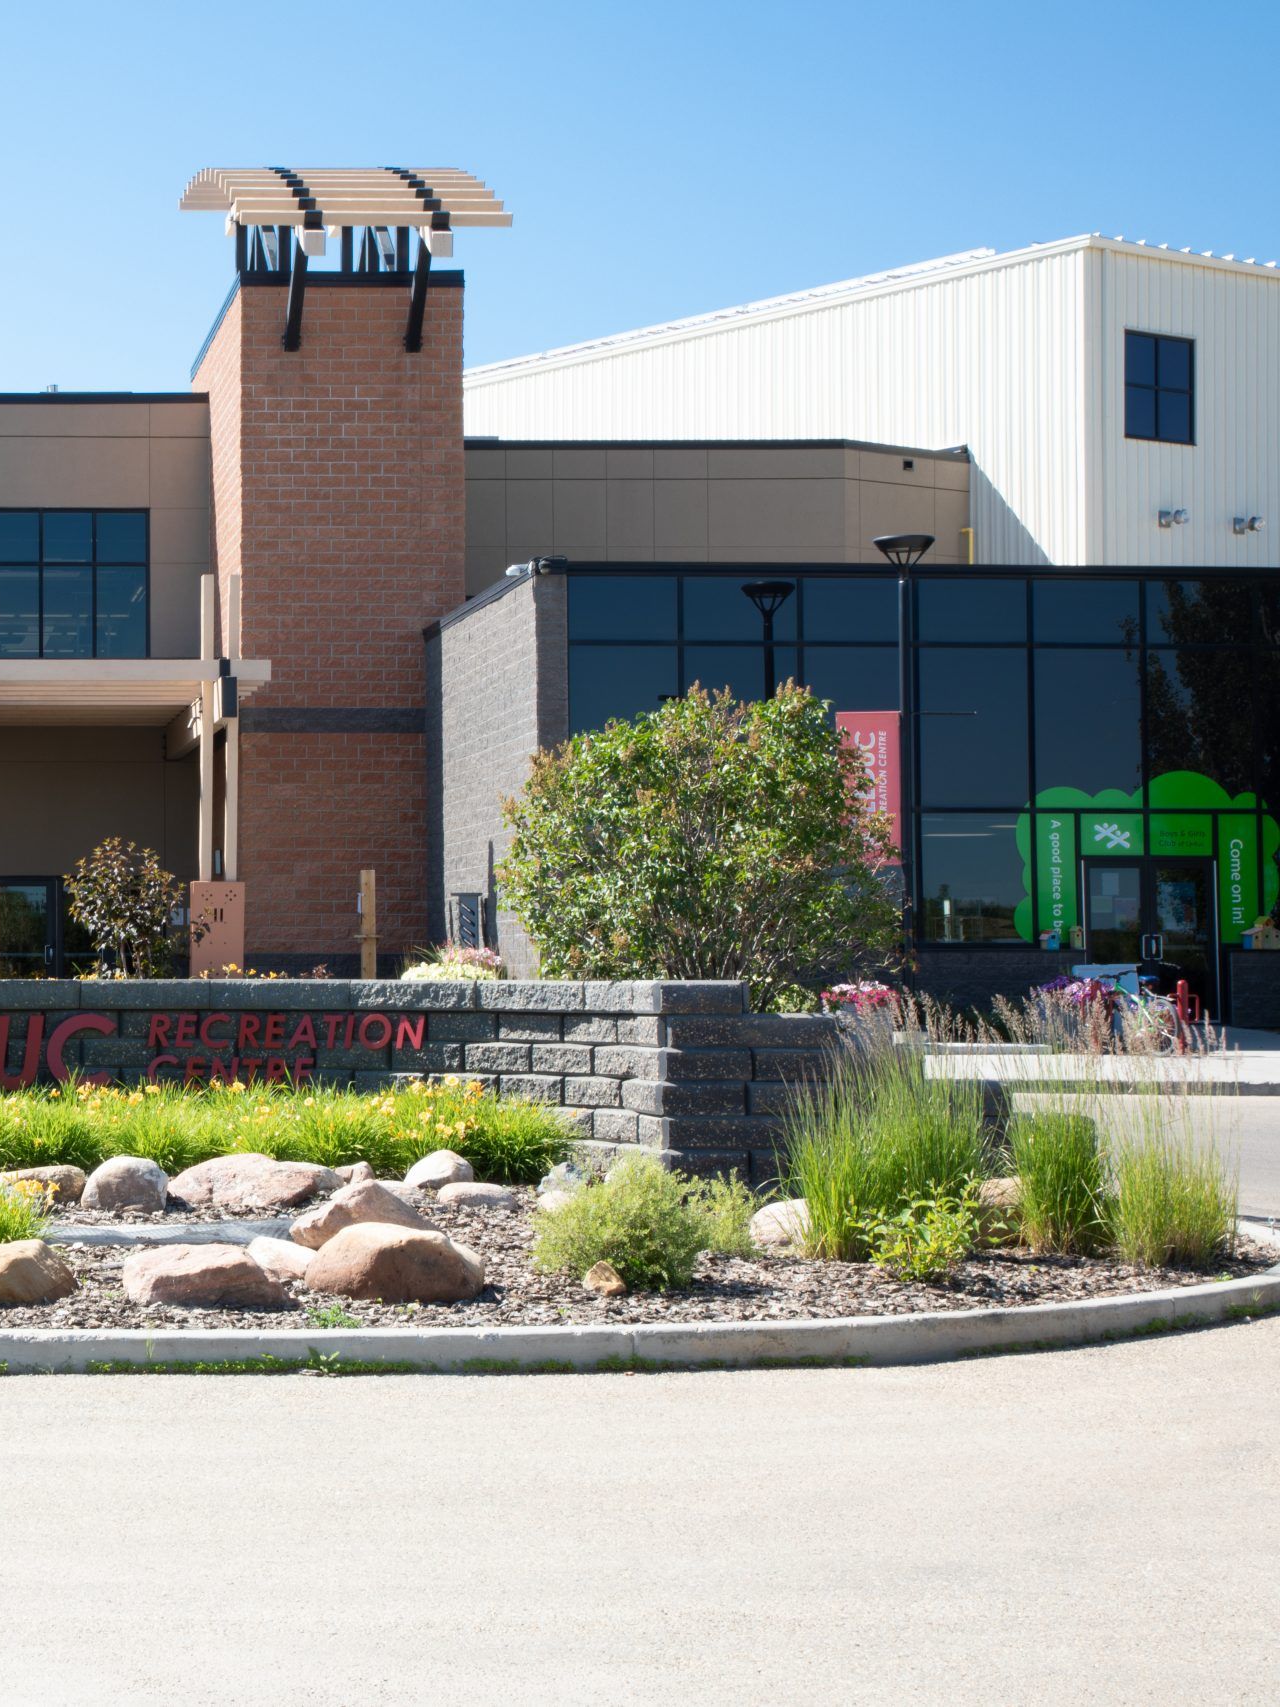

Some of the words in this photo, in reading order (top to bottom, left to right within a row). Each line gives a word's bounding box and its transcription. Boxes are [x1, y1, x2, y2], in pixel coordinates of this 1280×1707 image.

[878, 731, 887, 767] CENTRE
[1050, 820, 1061, 829] A
[1049, 832, 1063, 863] good
[1230, 839, 1244, 881] Come
[1050, 867, 1063, 900] place
[1231, 884, 1242, 903] on
[1052, 903, 1063, 916] to
[1232, 906, 1245, 924] in!
[147, 1013, 426, 1050] RECREATION
